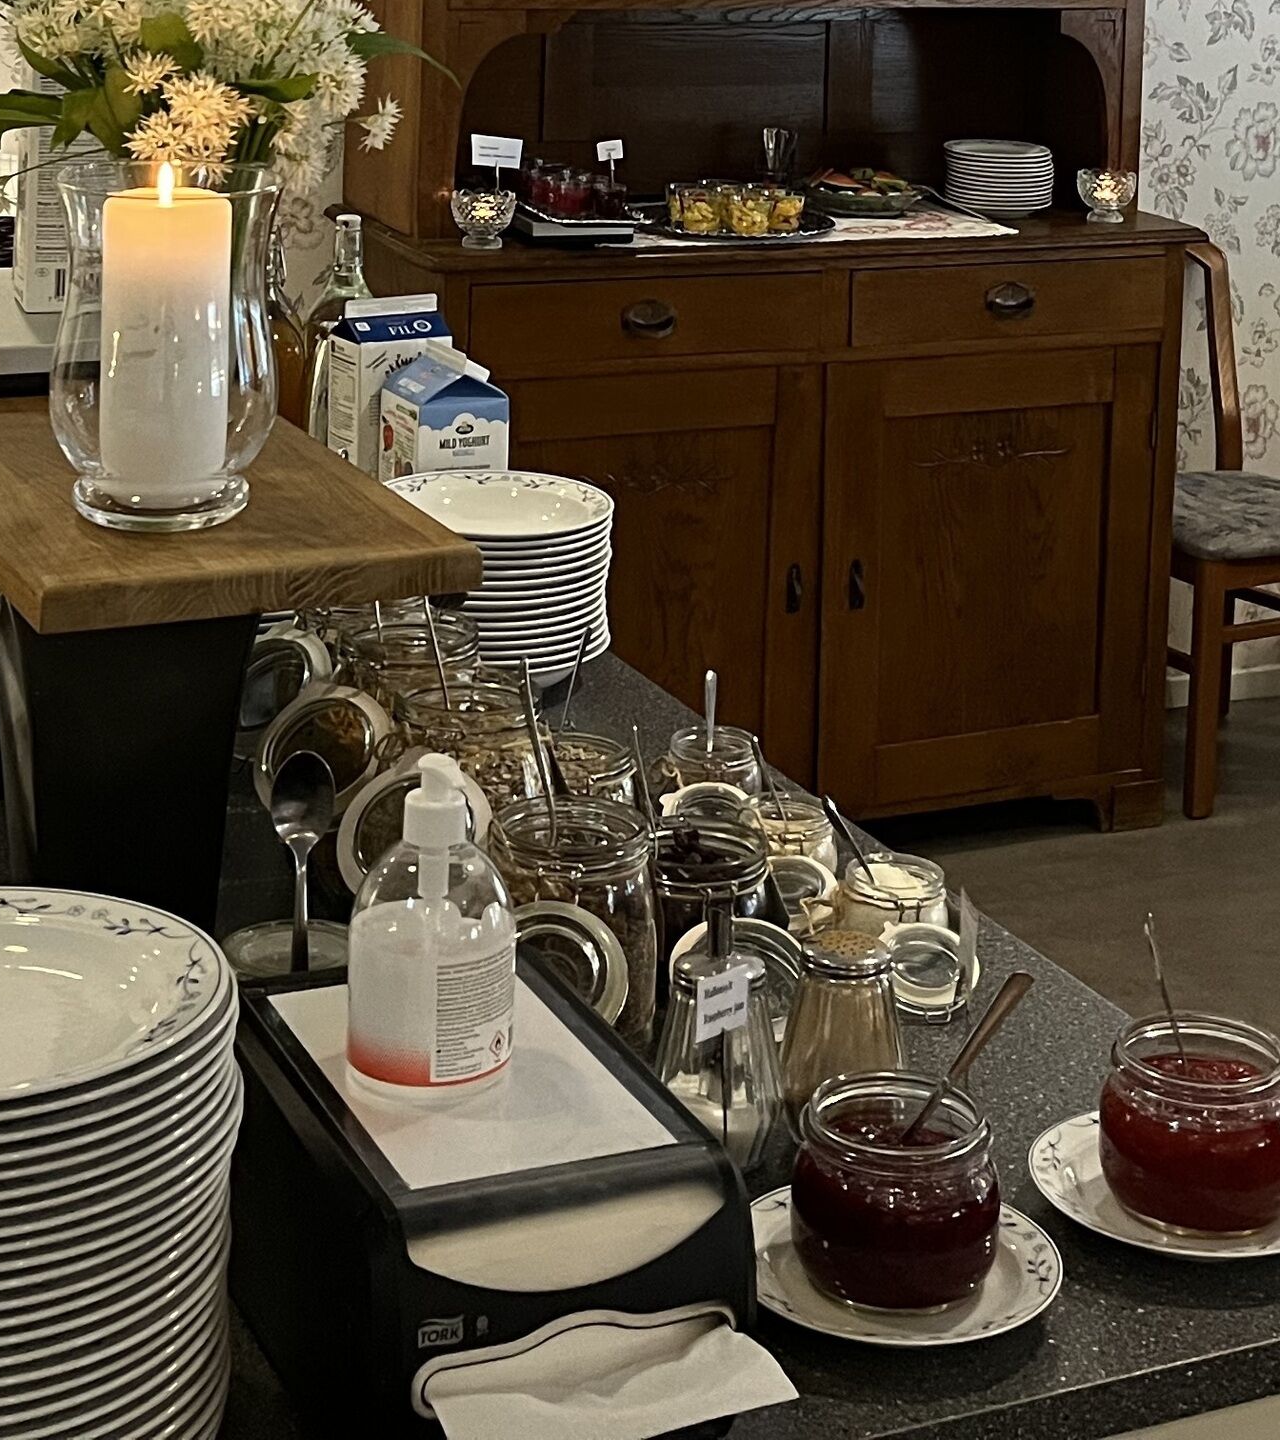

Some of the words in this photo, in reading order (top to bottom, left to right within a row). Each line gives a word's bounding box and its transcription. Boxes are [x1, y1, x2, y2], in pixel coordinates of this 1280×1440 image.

[439, 438, 457, 450] MILD
[458, 434, 491, 449] YOGHURT
[420, 1326, 460, 1345] TORK
